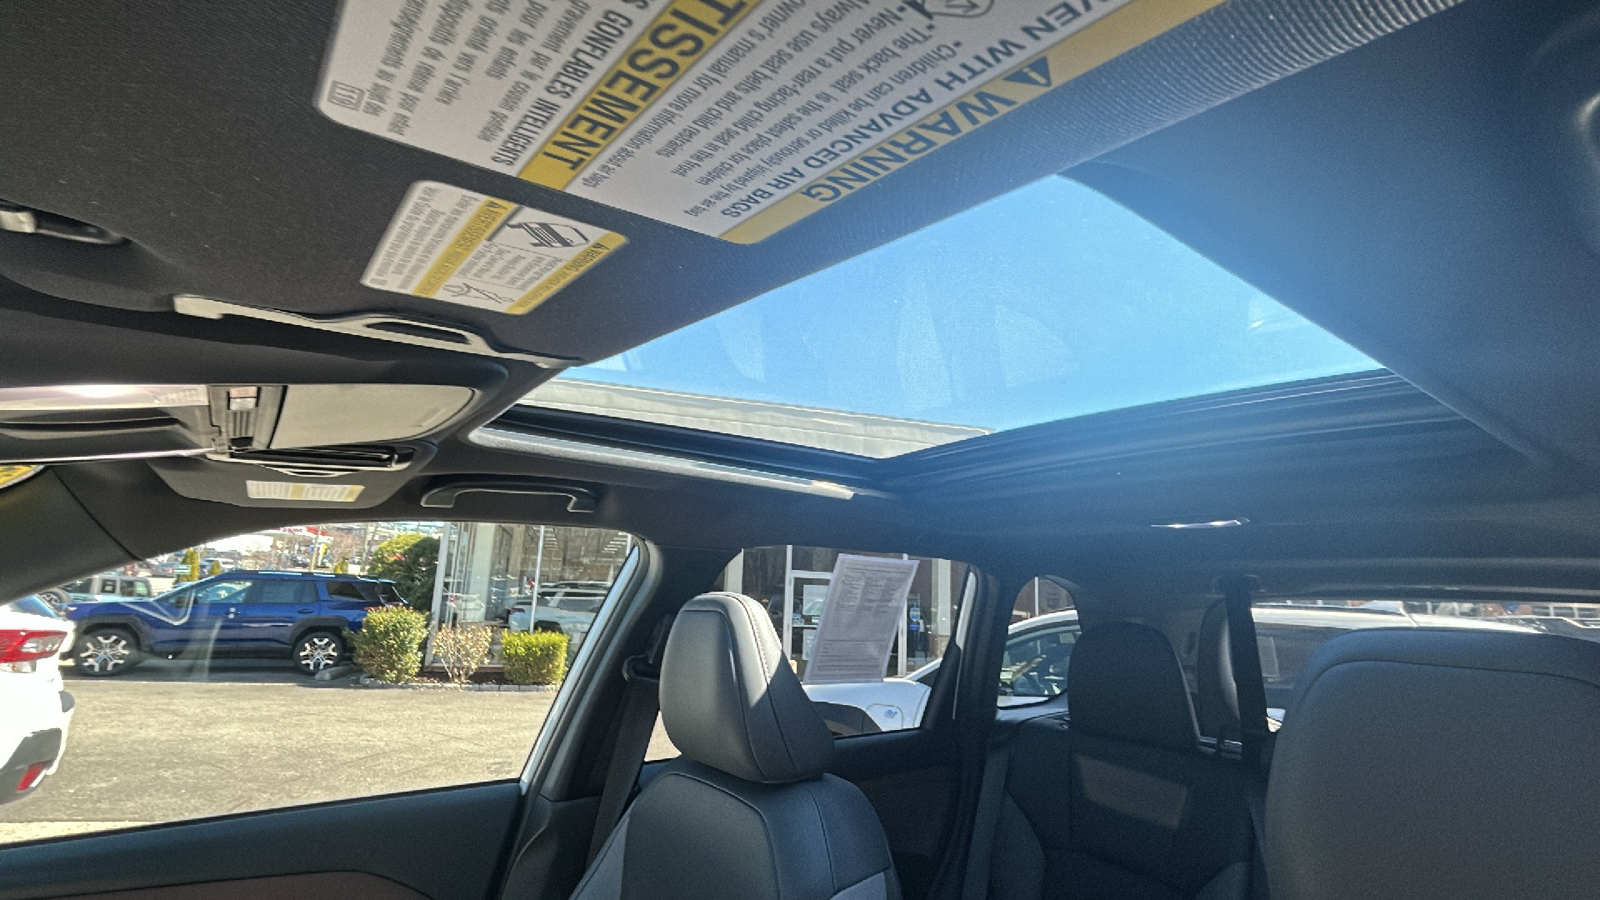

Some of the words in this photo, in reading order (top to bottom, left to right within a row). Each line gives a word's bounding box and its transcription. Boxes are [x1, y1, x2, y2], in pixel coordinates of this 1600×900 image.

[785, 29, 818, 52] use
[824, 37, 856, 62] put
[544, 9, 633, 98] GONFLABLES
[706, 36, 757, 78] manual
[759, 48, 794, 74] seat
[813, 57, 832, 68] a
[857, 46, 902, 73] back
[933, 38, 1026, 91] WITH
[692, 72, 721, 90] for
[733, 69, 773, 94] belts
[752, 64, 823, 112] rear-facing
[829, 69, 864, 93] seat
[863, 81, 894, 101] can
[667, 86, 702, 111] more
[714, 90, 743, 112] and
[795, 99, 824, 116] the
[814, 90, 838, 102] is
[847, 97, 874, 111] be
[624, 107, 682, 150] information
[691, 106, 723, 130] child
[731, 109, 764, 132] child
[764, 112, 803, 138] safest
[802, 86, 933, 168] ADVANCED
[816, 108, 857, 132] killed
[490, 97, 561, 166] INTELLIGENTS
[712, 127, 740, 145] seat
[739, 132, 772, 154] place
[804, 128, 823, 140] or
[689, 149, 714, 162] the
[703, 141, 725, 152] in
[759, 136, 810, 167] seriously
[795, 89, 1018, 201] WARNING
[727, 151, 751, 164] for
[732, 164, 772, 187] injured
[765, 166, 805, 189] AIR
[720, 187, 774, 217] BAGS
